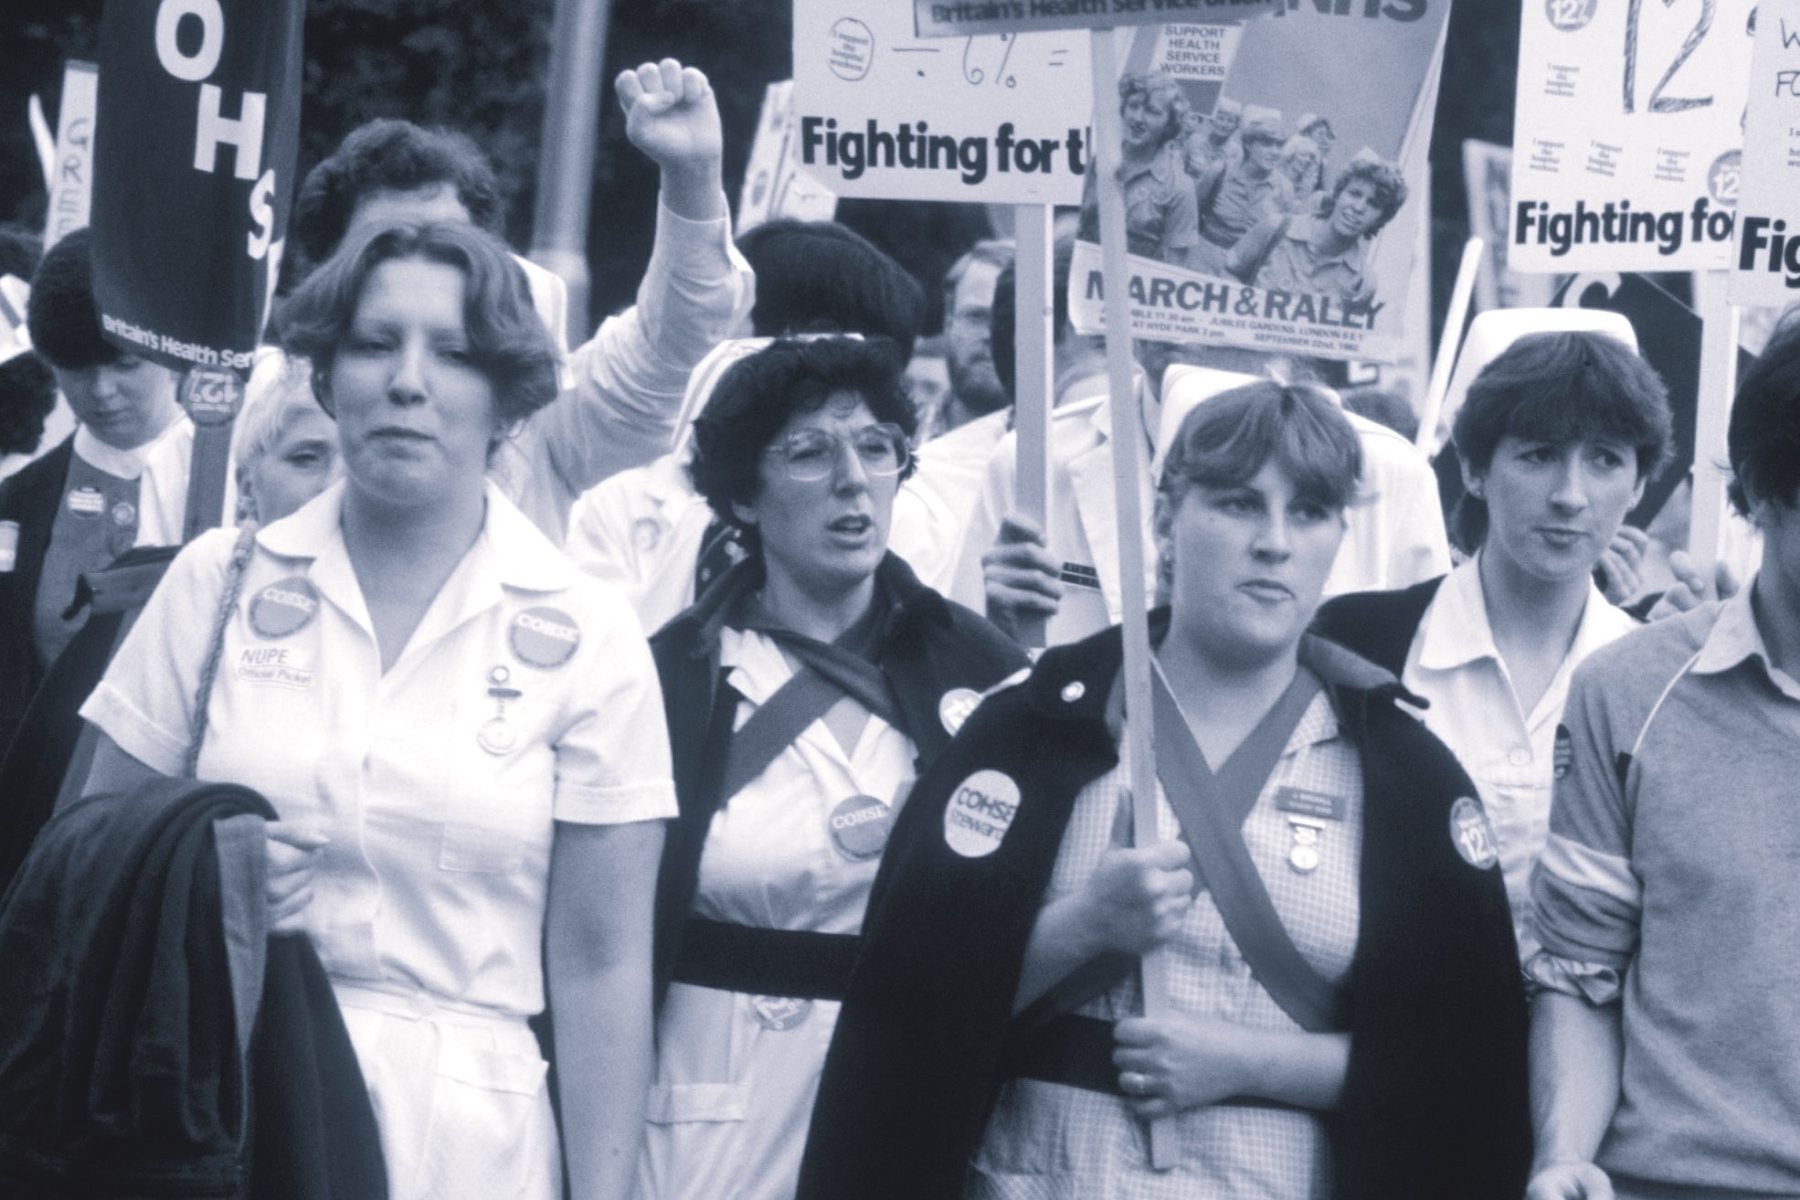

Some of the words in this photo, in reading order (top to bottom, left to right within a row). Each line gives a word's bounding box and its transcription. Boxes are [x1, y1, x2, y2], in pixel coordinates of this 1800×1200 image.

[1164, 26, 1226, 38] SUPPORT
[1168, 38, 1221, 51] HEALTH
[1166, 50, 1221, 64] SERVICE
[1160, 63, 1226, 77] WORKERS
[802, 116, 987, 185] Fighting
[995, 122, 1060, 174] for
[1066, 126, 1092, 176] t
[1515, 199, 1684, 257] Fighting
[1234, 286, 1259, 317] &
[1264, 288, 1386, 331] RALLY
[160, 335, 218, 365] Health
[241, 648, 290, 664] NUPE
[958, 787, 1017, 823] COHSE
